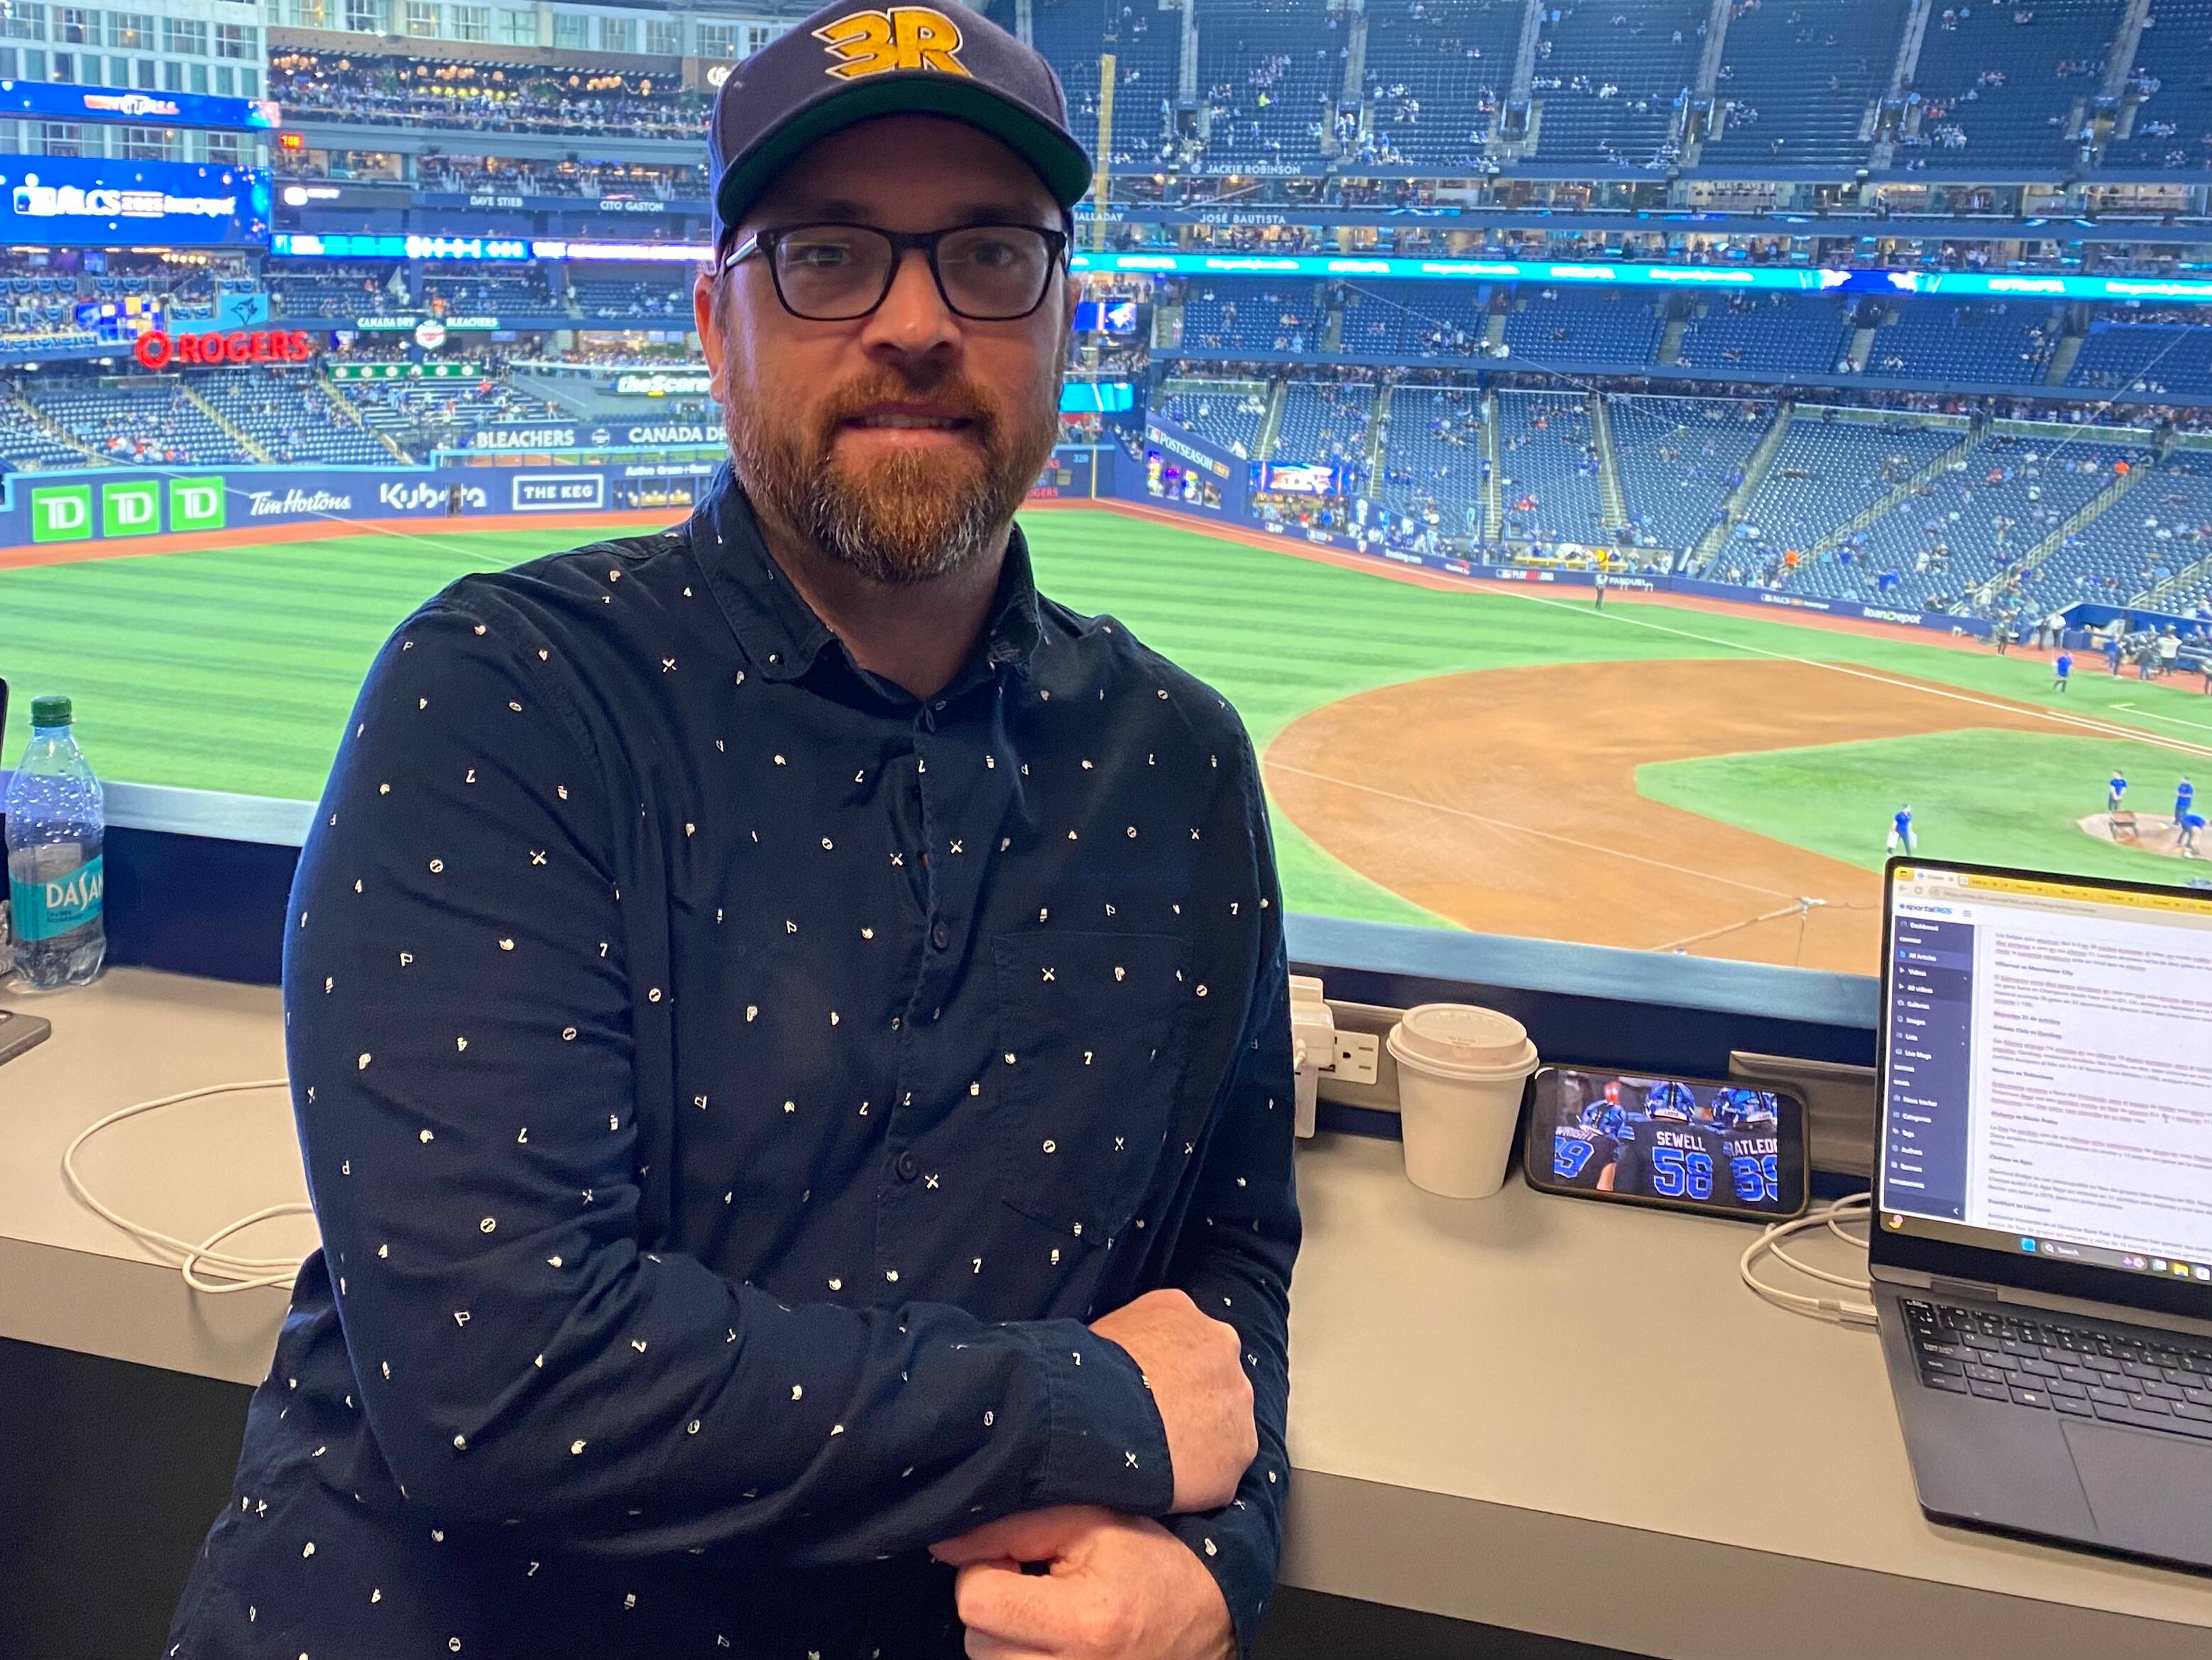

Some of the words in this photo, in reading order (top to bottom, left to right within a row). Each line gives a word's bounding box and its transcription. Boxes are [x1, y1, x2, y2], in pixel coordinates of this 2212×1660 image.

[812, 6, 974, 81] 3R
[1206, 164, 1242, 174] JACKIE
[1245, 165, 1301, 175] ROBINSON
[470, 195, 494, 206] DAVE
[600, 200, 623, 211] CITO
[625, 202, 664, 212] GASTON
[1199, 213, 1228, 224] JOSÉ
[1232, 214, 1287, 224] BAUTISTA
[357, 317, 395, 327] CANADA
[396, 317, 416, 327] DRY
[178, 331, 310, 364] ROGERS
[476, 429, 575, 449] BLEACHERS
[628, 427, 703, 443] CANADA
[1073, 454, 1089, 464] 328
[1159, 431, 1213, 471] POSTSEASON
[175, 486, 218, 519] TD
[249, 491, 282, 516] Tim
[281, 488, 351, 513] Hortons
[524, 485, 557, 500] THE
[561, 484, 593, 498] KEG
[39, 496, 85, 530] TD
[108, 491, 153, 525] TD
[1656, 1130, 1707, 1152] SEWELL
[1652, 1145, 1714, 1201] 58
